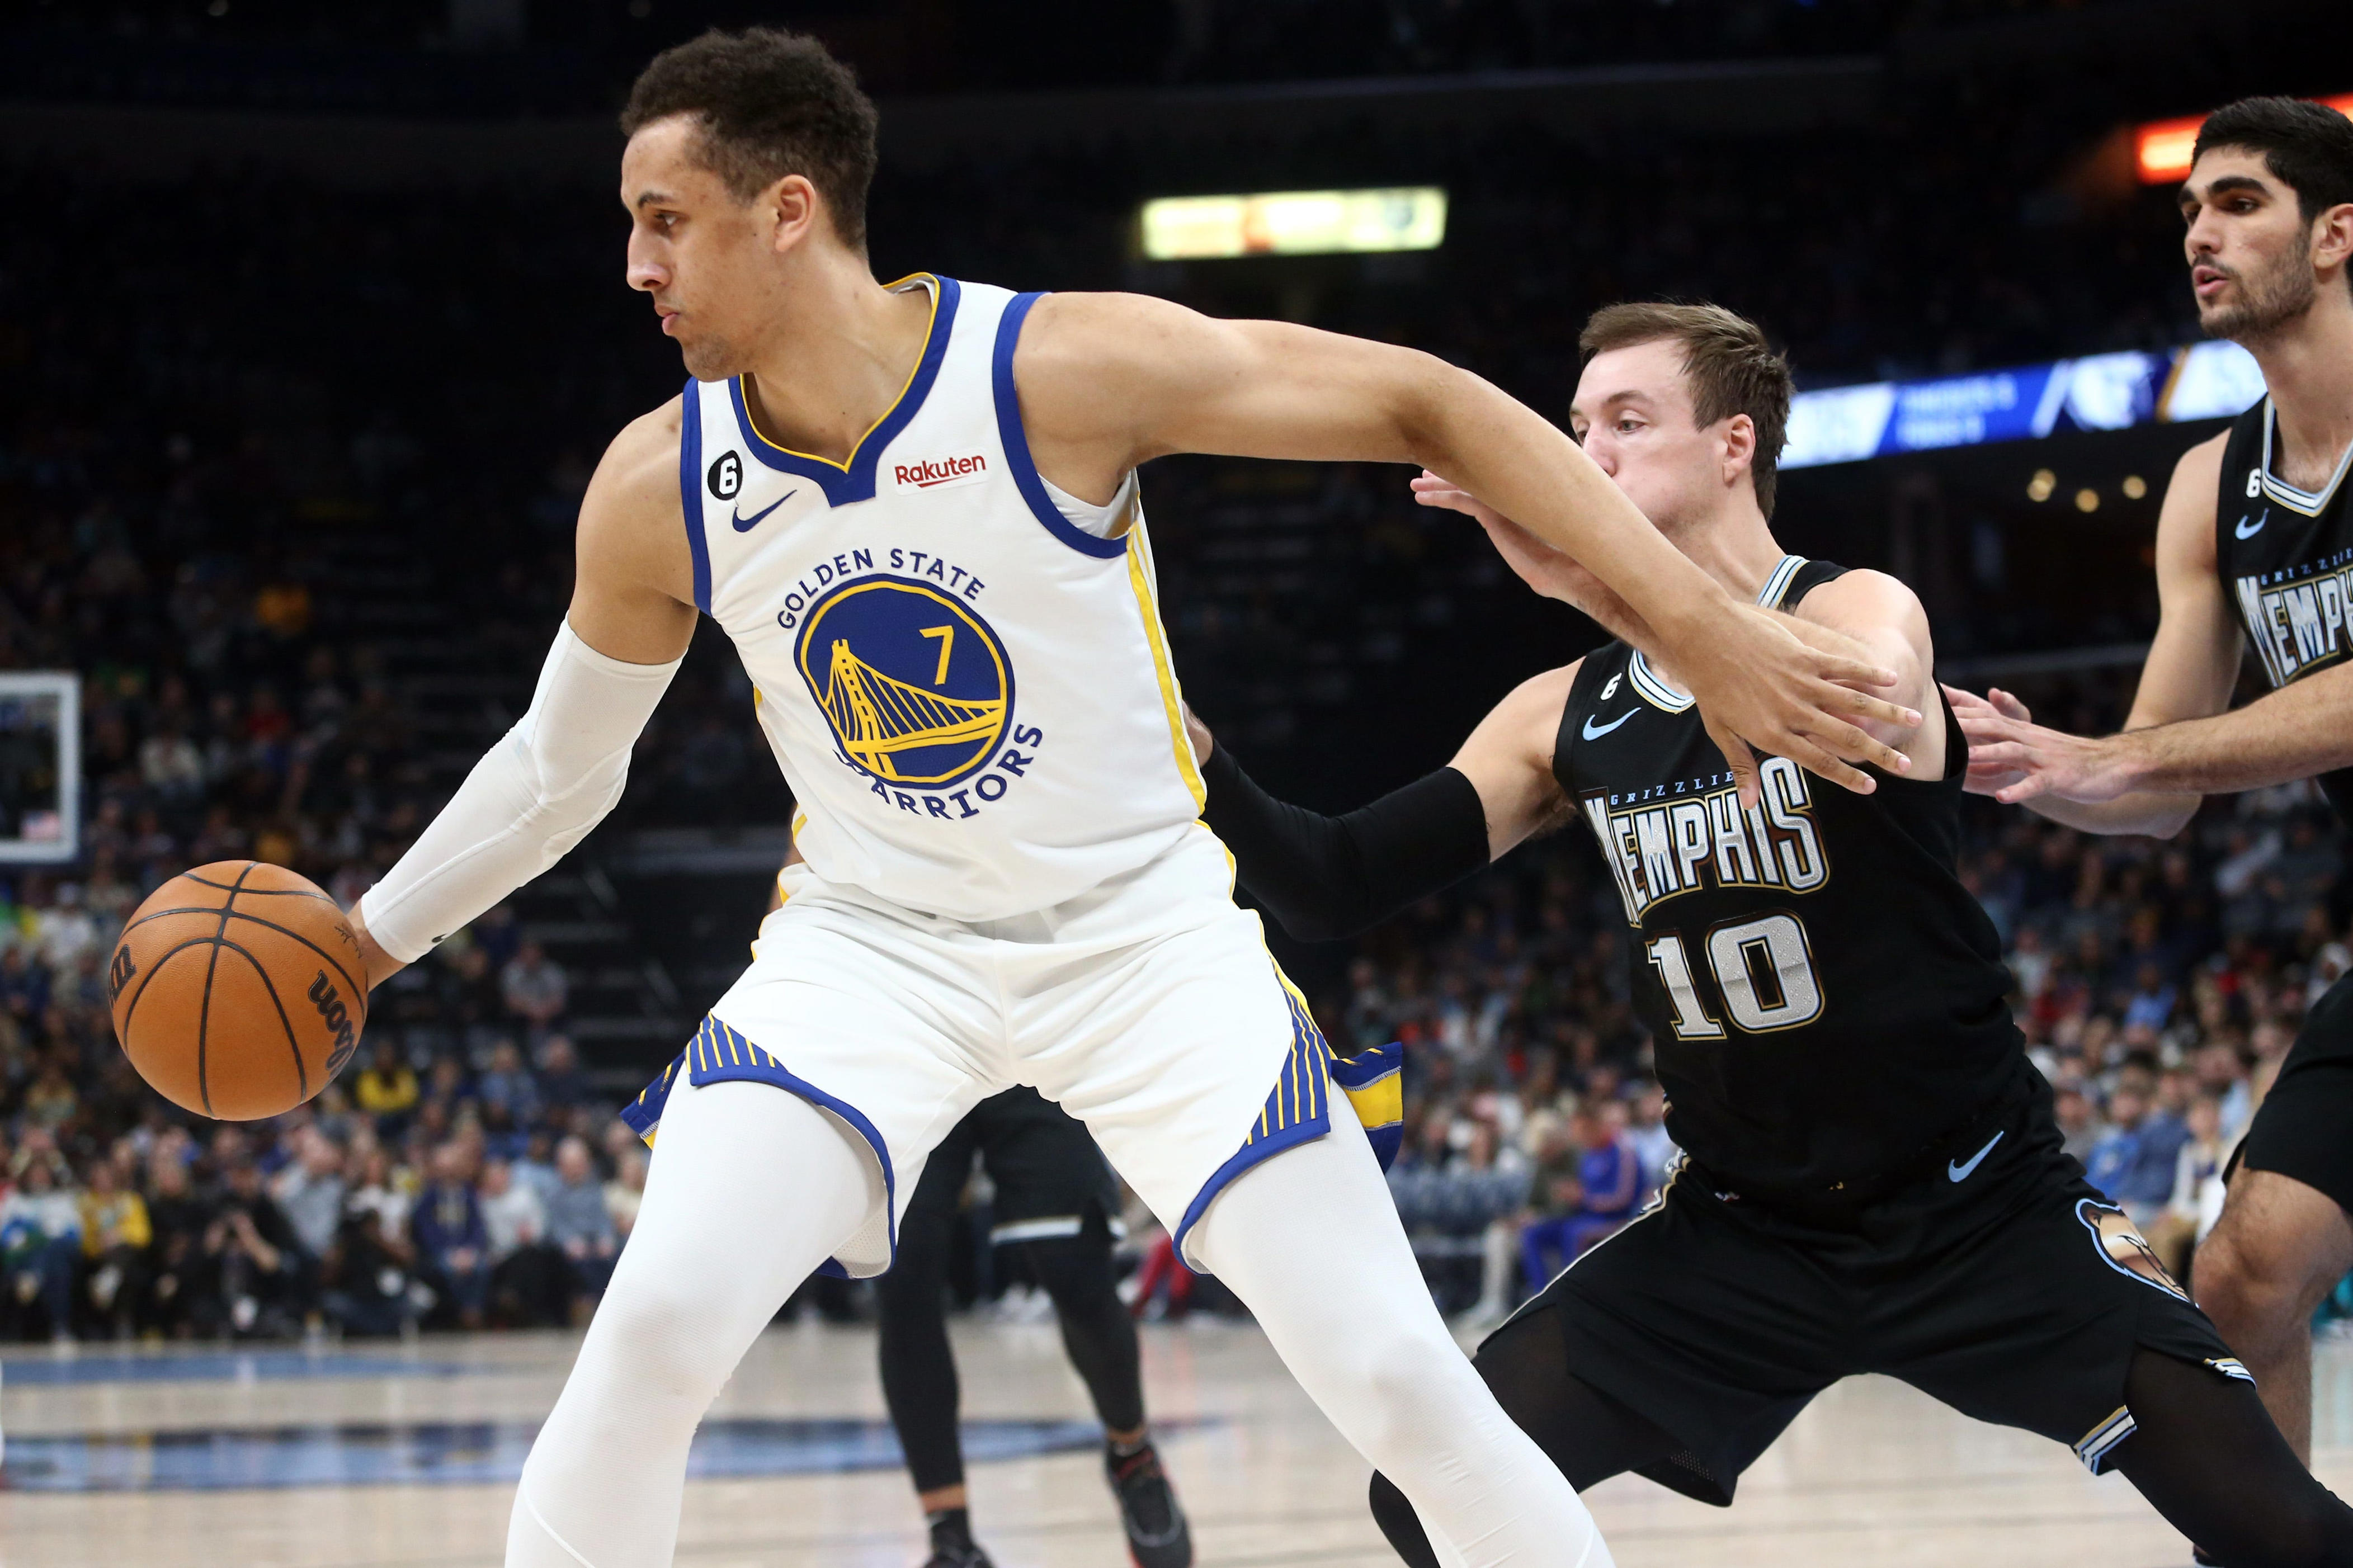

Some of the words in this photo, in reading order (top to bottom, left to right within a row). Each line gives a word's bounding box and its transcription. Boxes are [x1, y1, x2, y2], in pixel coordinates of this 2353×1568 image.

[718, 457, 738, 495] 6
[894, 455, 987, 485] Rakuten
[2246, 467, 2262, 498] 6
[2260, 547, 2353, 587] GRIZZLIE
[777, 548, 874, 630] GOLDEN
[890, 548, 985, 601] STATE
[919, 625, 955, 686] 7
[1600, 672, 1622, 701] 6
[1610, 771, 1733, 806] GRIZZLIE
[1582, 755, 1829, 927] MEMPHIS
[1645, 911, 1827, 1041] 10
